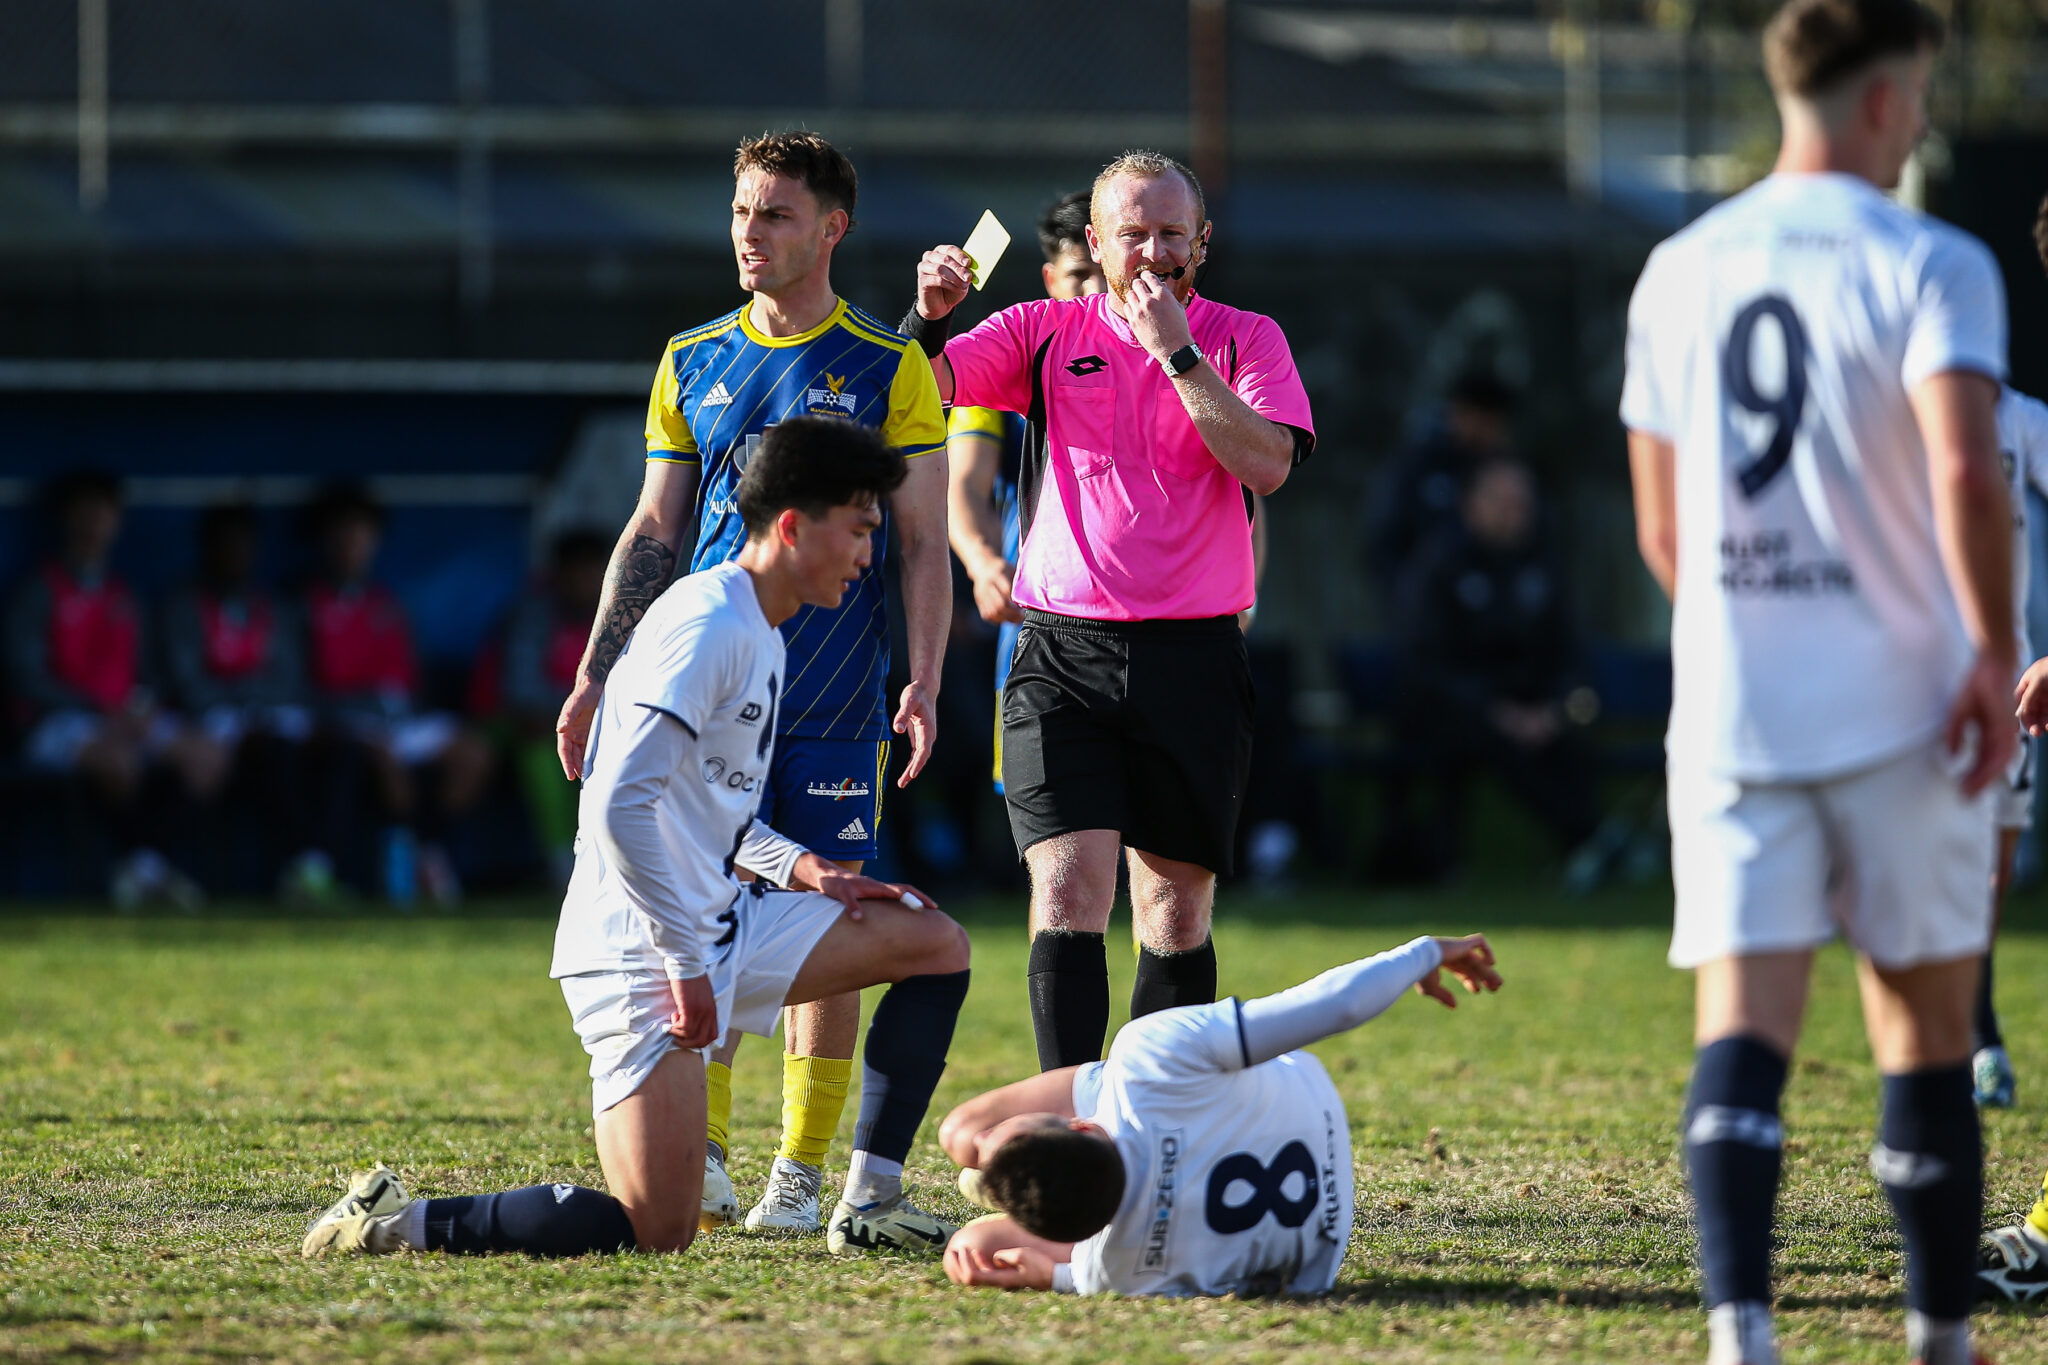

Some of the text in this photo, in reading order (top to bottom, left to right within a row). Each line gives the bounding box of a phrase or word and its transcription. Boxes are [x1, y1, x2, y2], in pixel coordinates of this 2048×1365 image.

[702, 395, 733, 408] adidas
[1723, 291, 1808, 498] 9
[711, 500, 738, 514] ALL IN
[837, 832, 868, 840] adidas
[1205, 1138, 1319, 1235] 8
